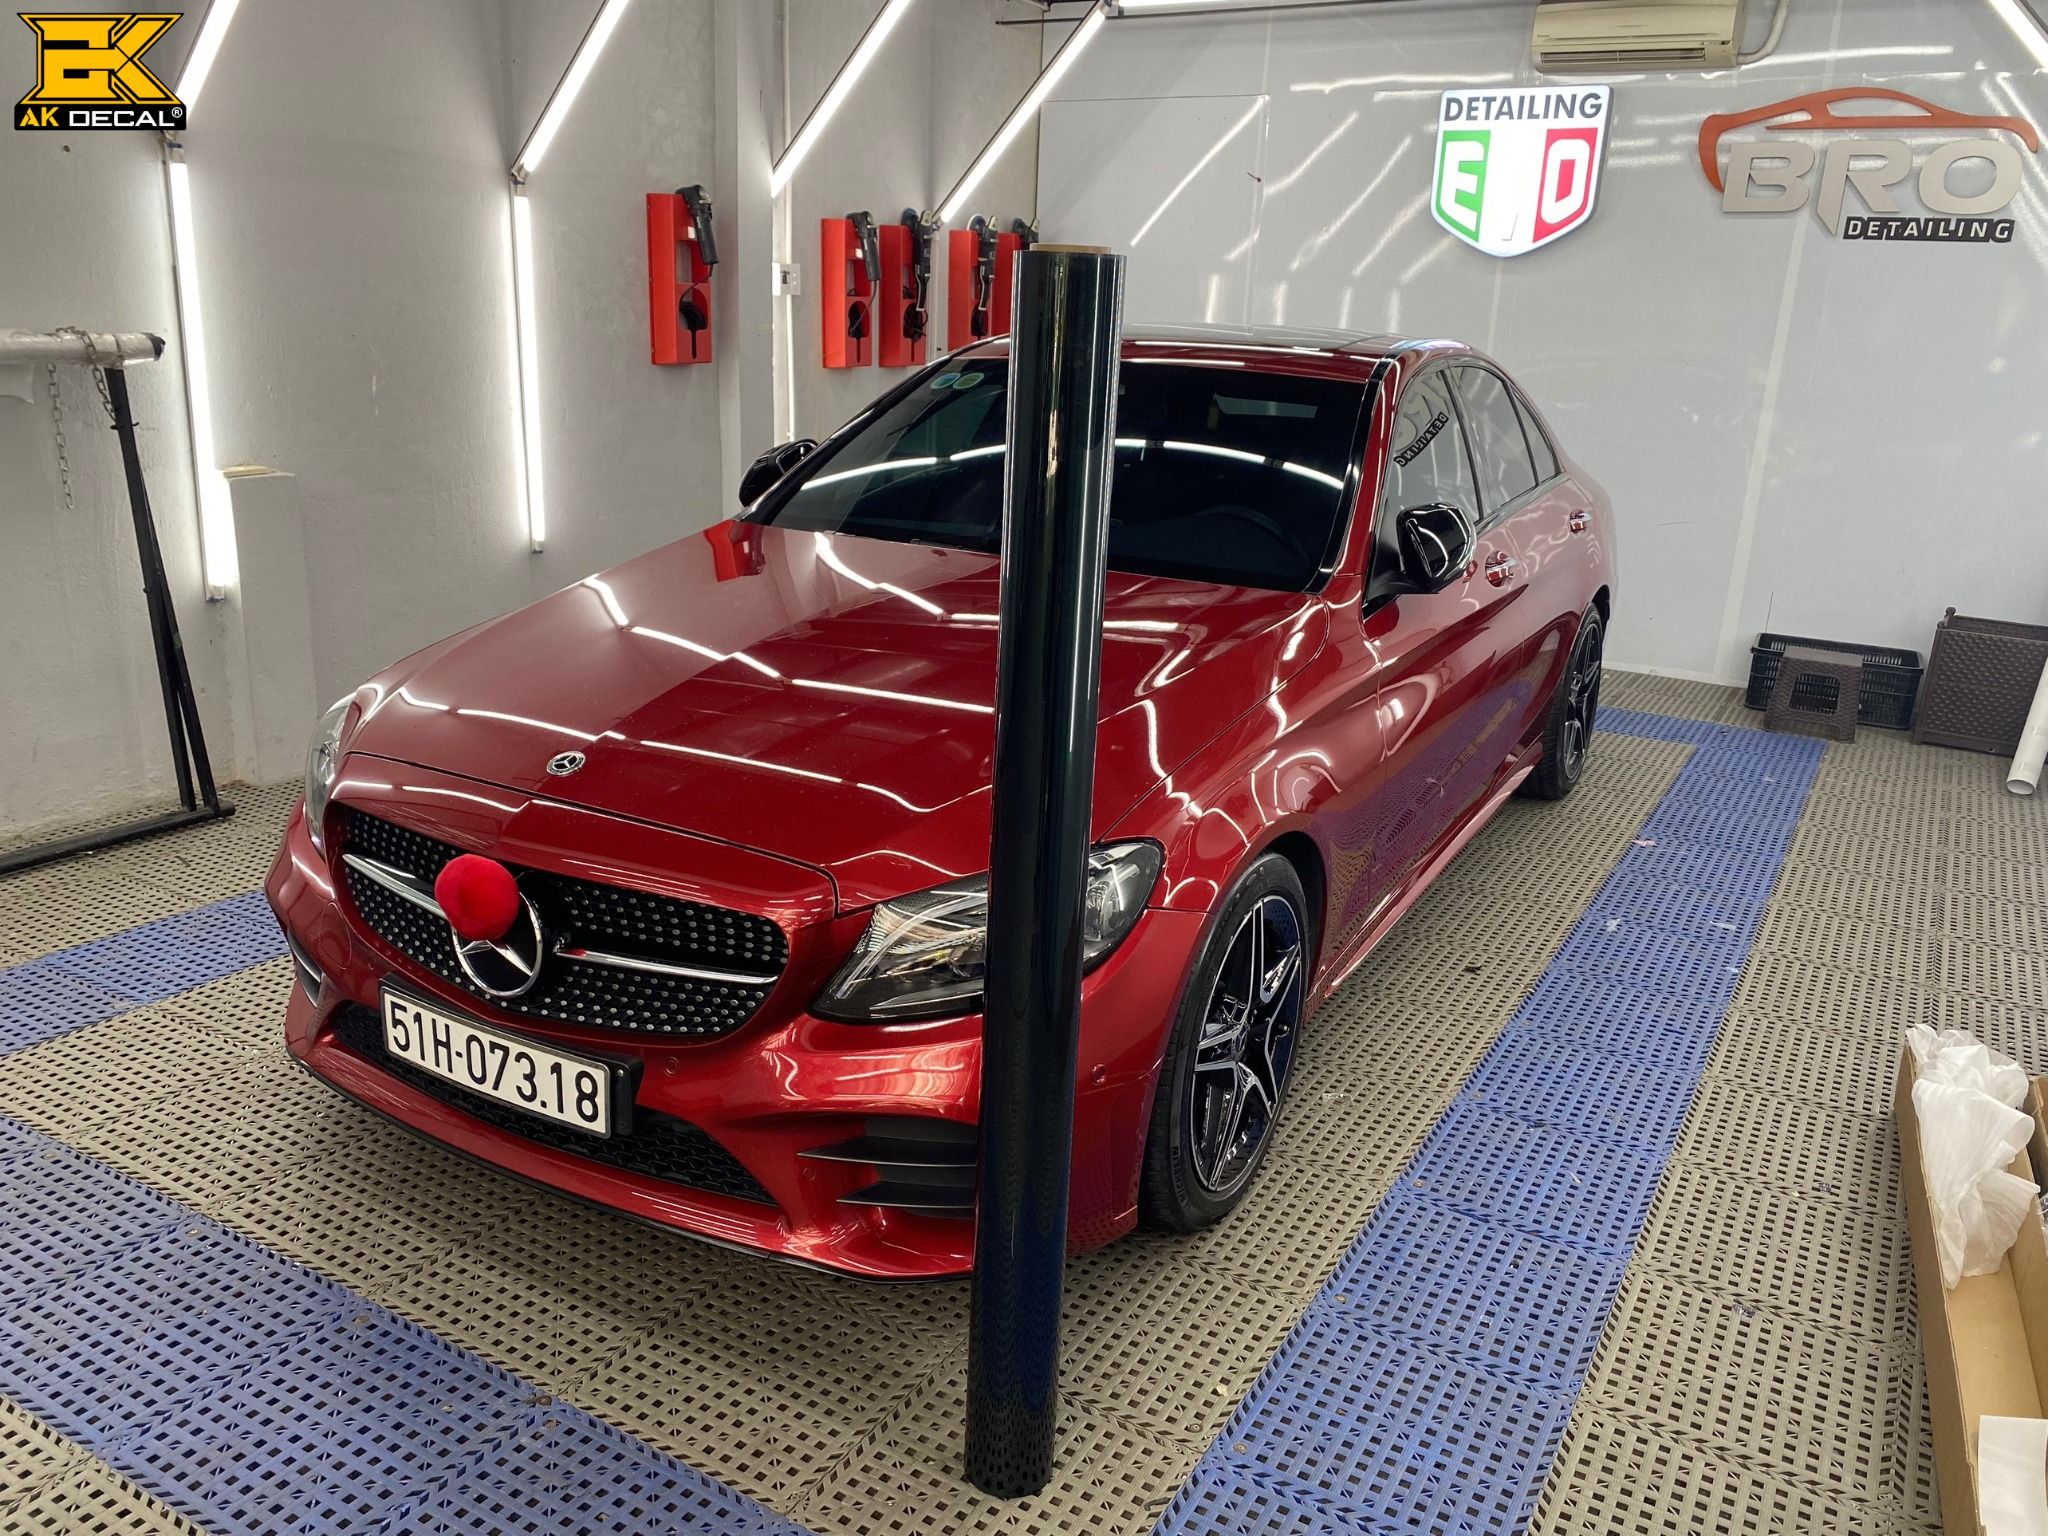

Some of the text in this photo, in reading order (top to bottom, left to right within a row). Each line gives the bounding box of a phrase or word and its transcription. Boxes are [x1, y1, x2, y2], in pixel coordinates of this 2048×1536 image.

[1444, 92, 1603, 122] DETAILING
[1722, 139, 2022, 235] BRO
[1847, 219, 2010, 239] DETAILING
[390, 1001, 599, 1123] 51H-073.18
